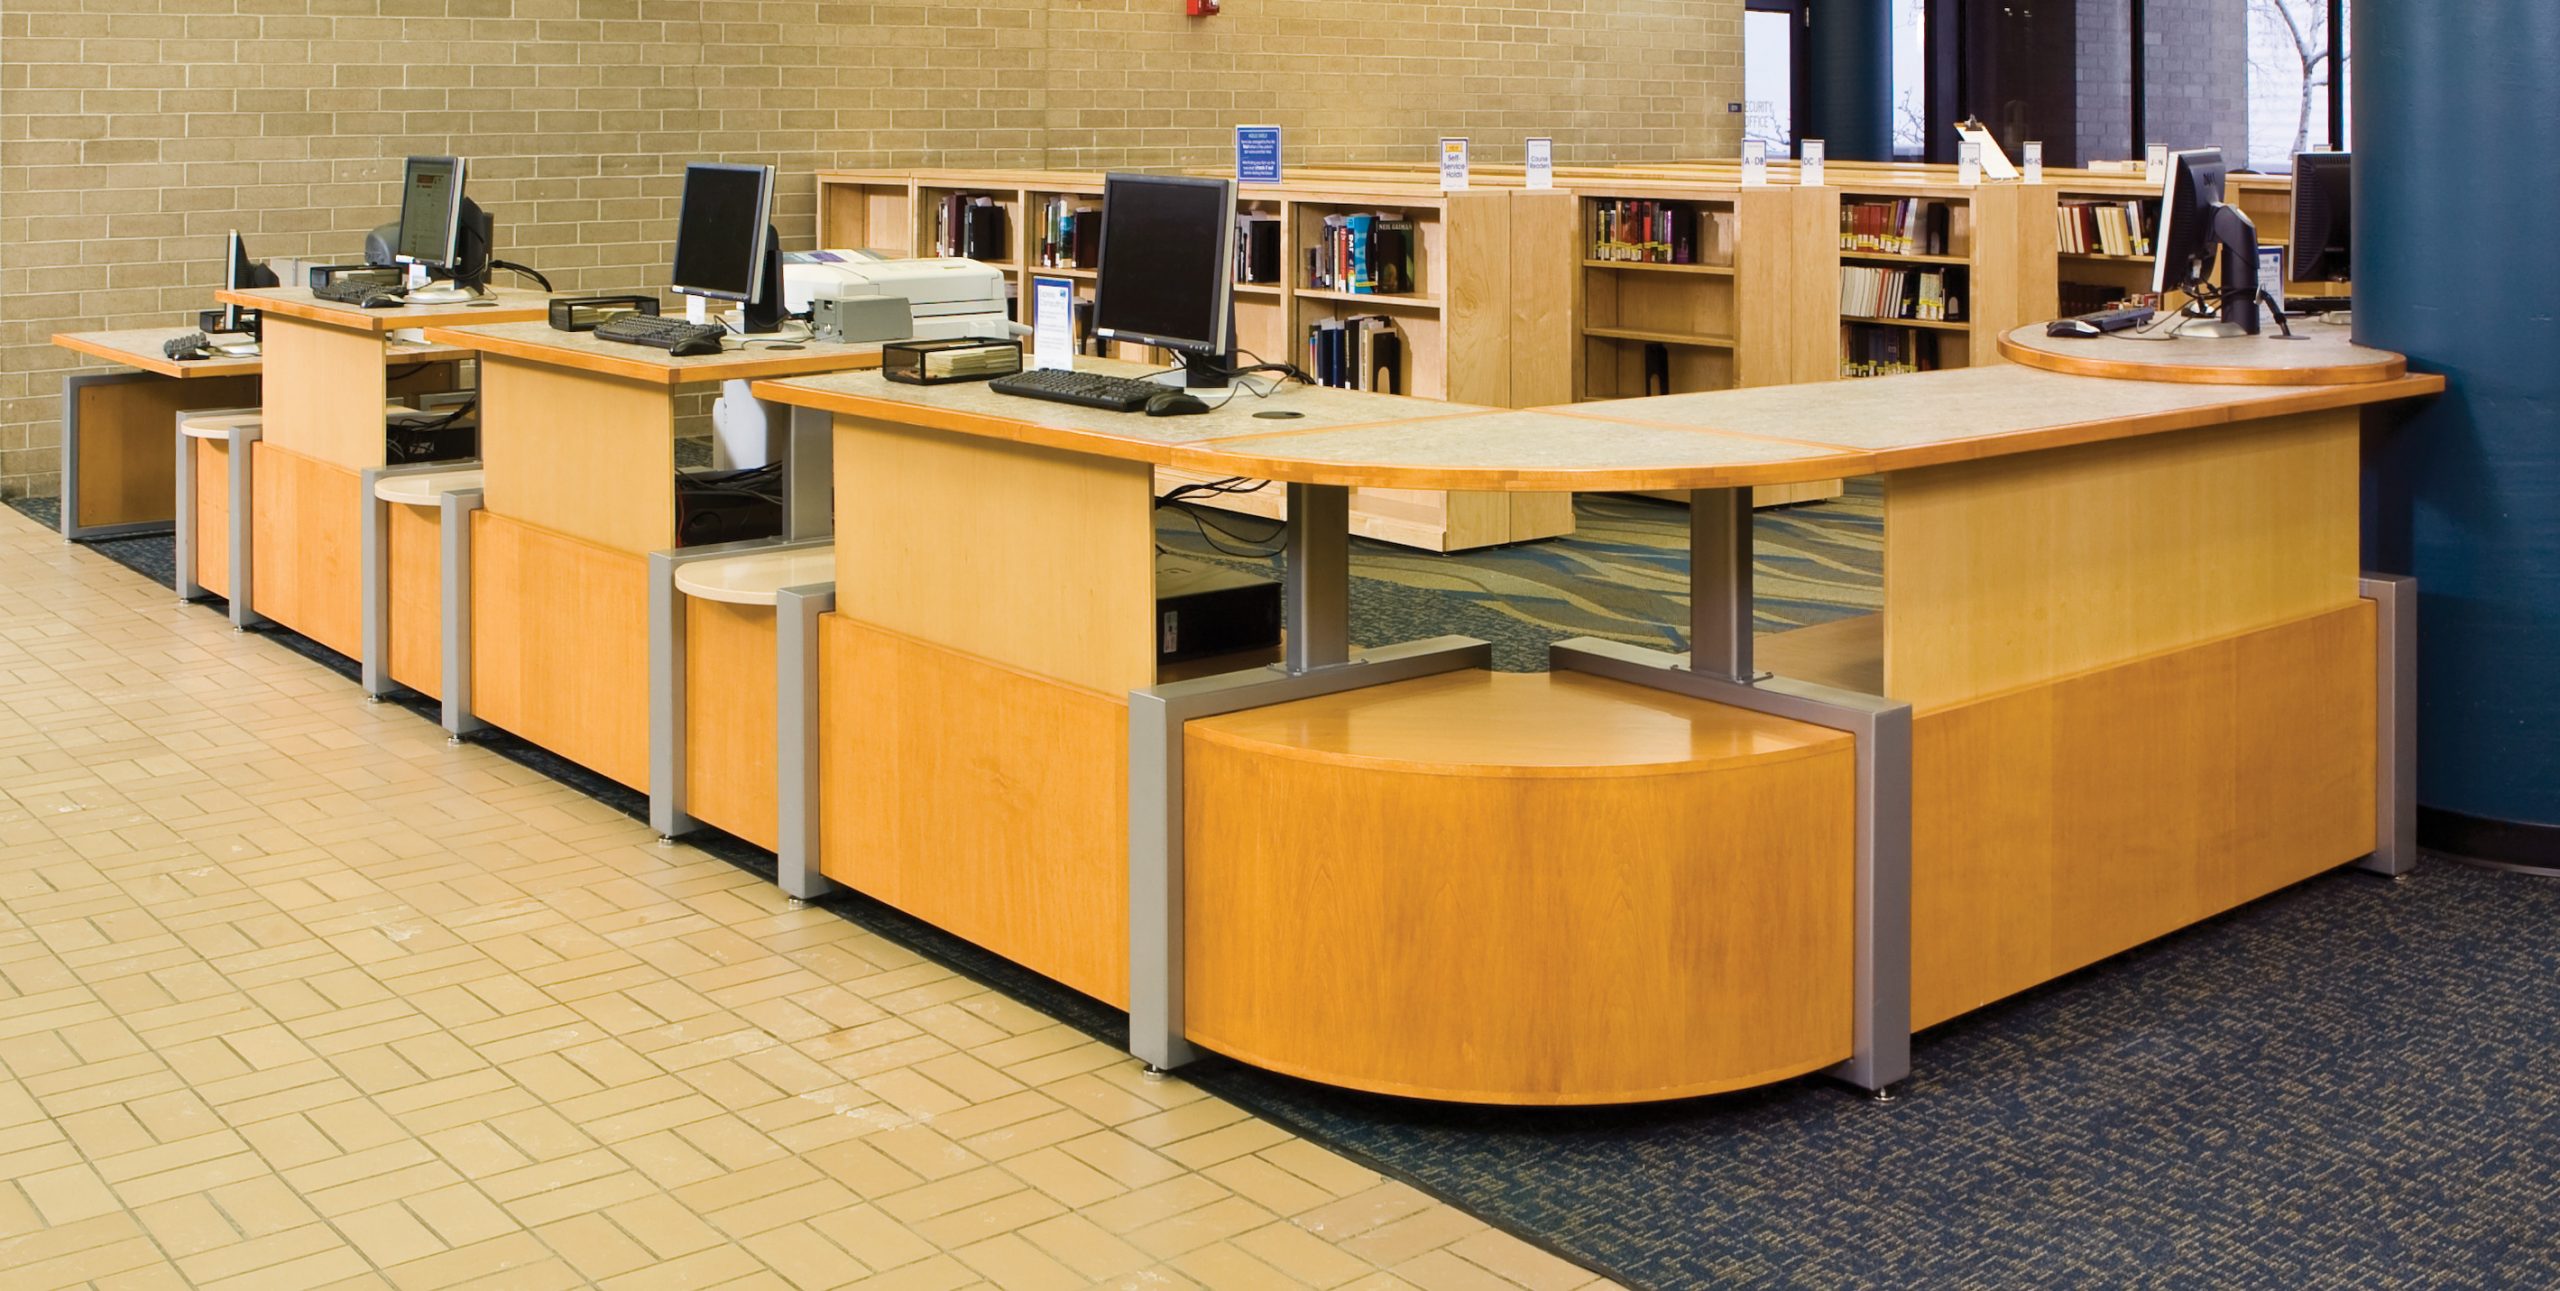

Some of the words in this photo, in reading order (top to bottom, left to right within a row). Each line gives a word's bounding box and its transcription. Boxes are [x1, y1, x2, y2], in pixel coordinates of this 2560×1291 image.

[1744, 101, 1773, 112] ECURITY
[1444, 162, 1465, 170] Service
[1379, 223, 1391, 231] NEIL
